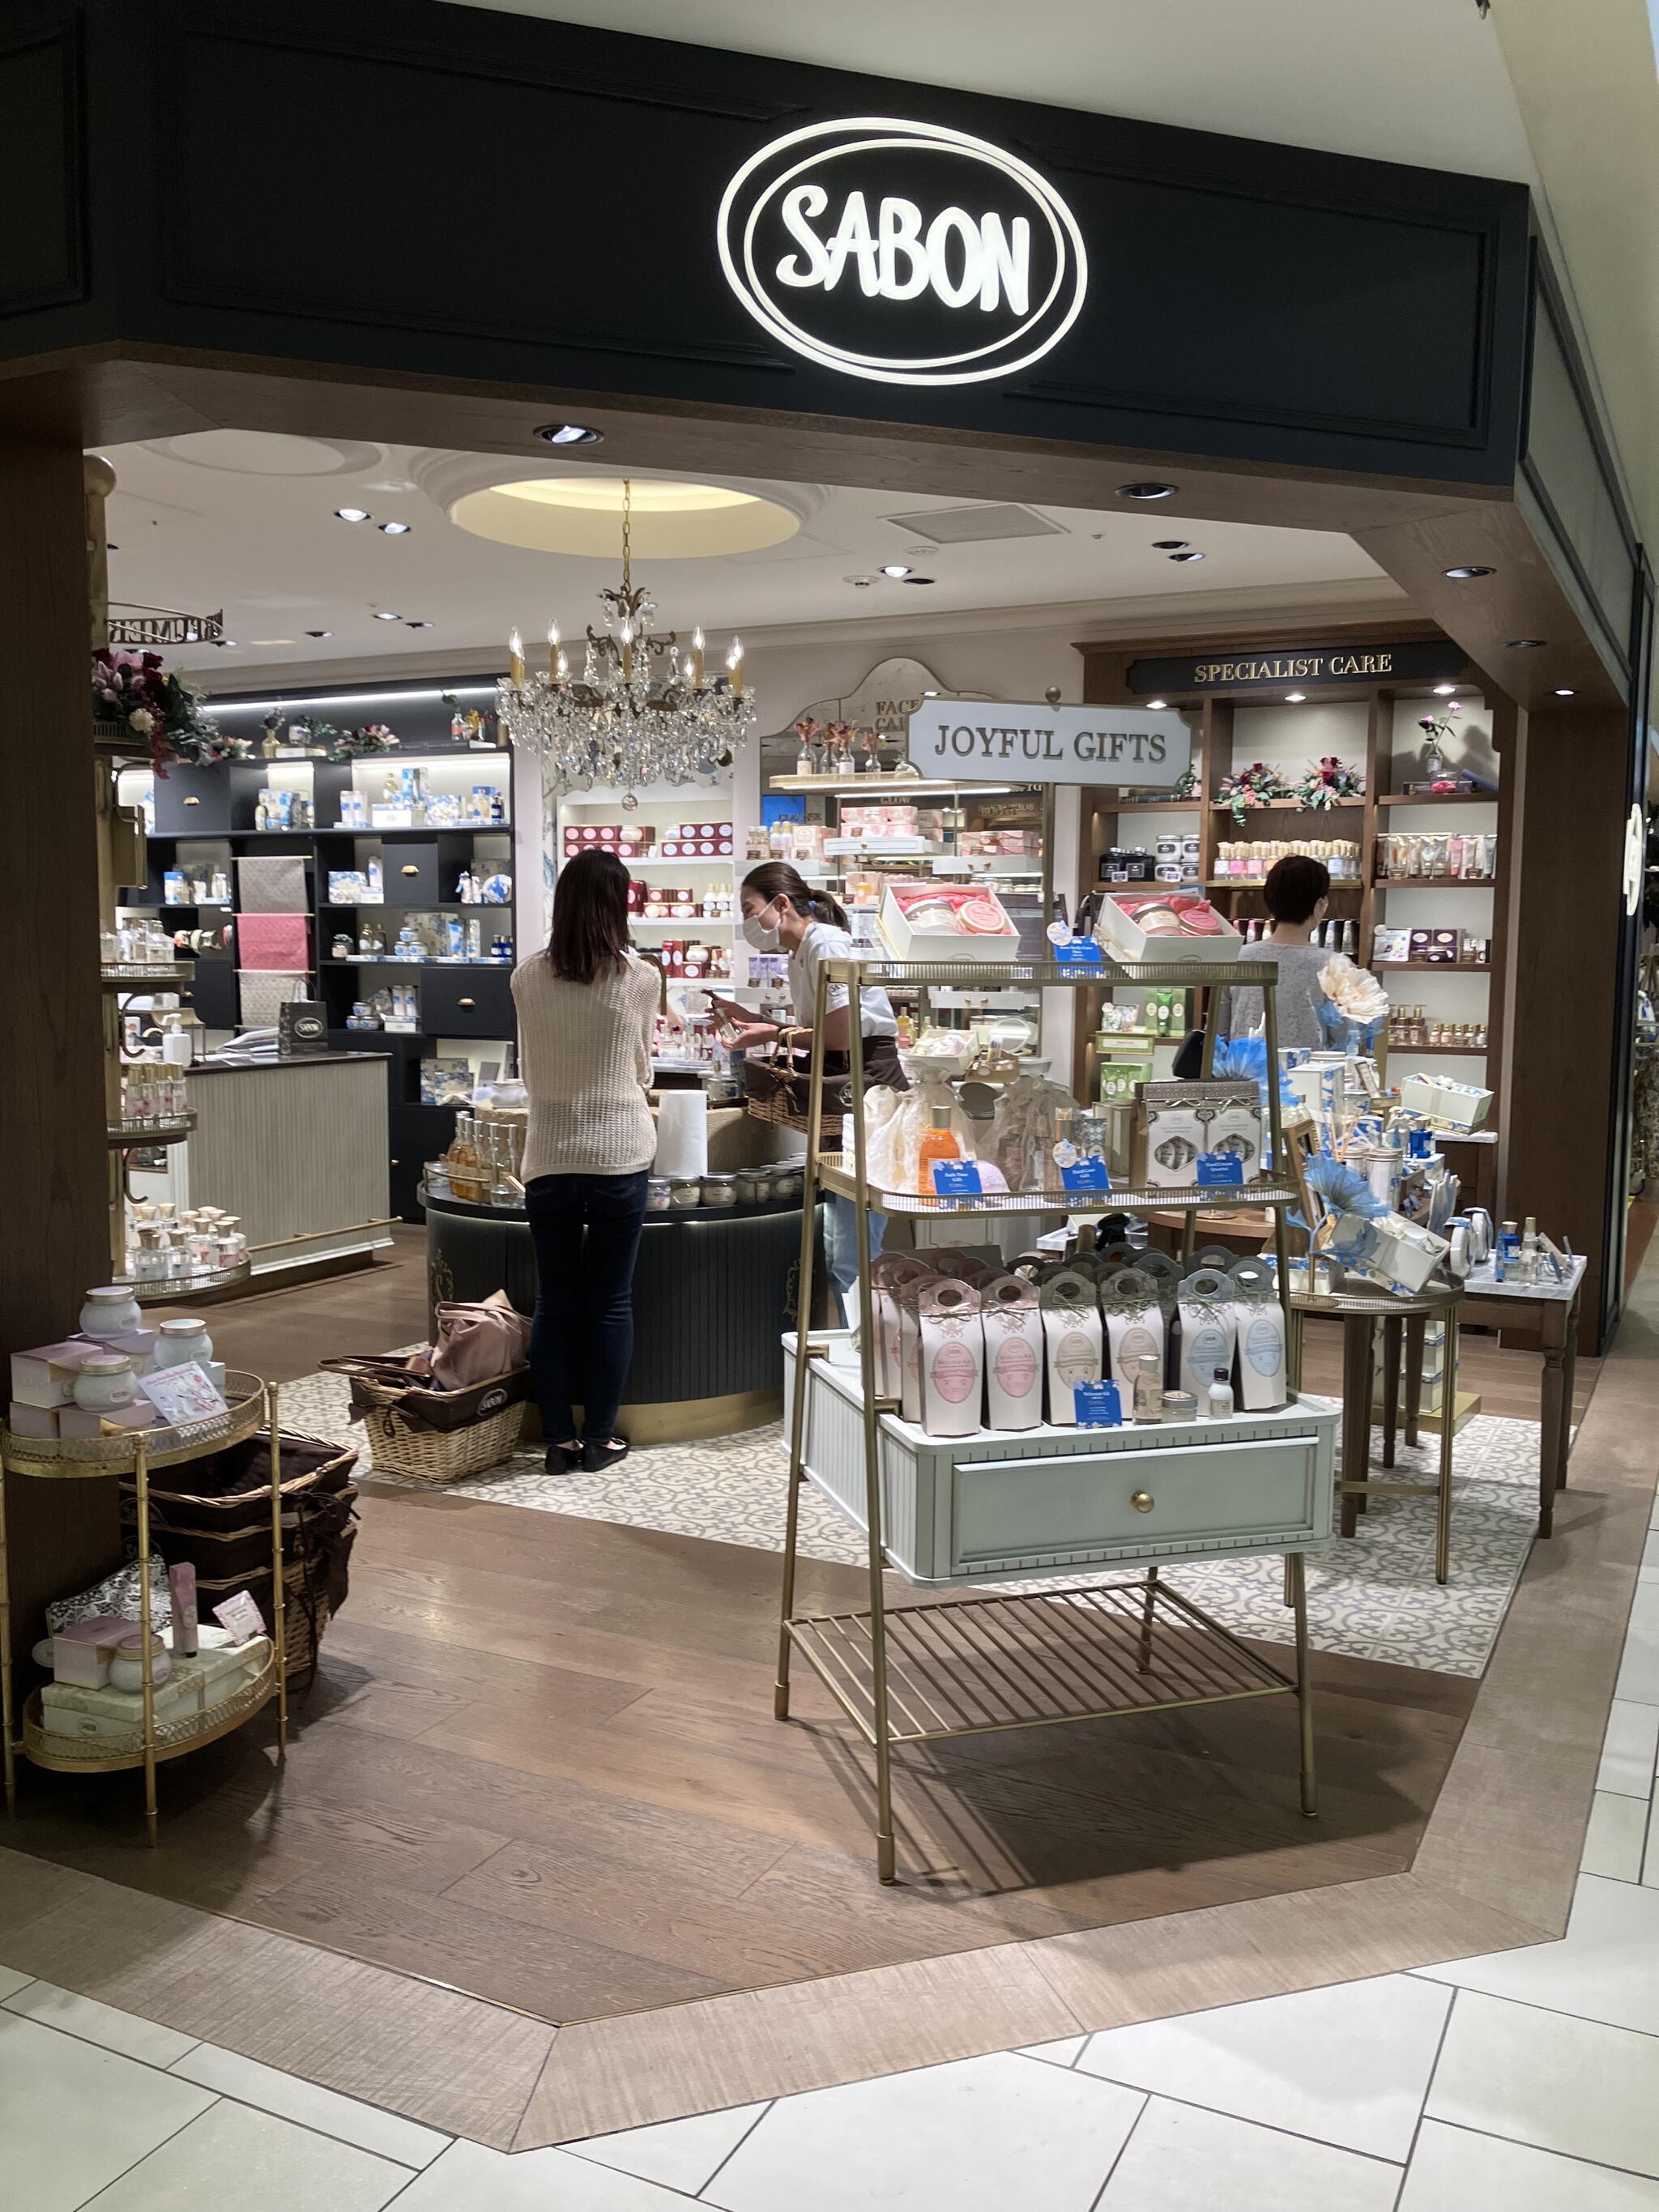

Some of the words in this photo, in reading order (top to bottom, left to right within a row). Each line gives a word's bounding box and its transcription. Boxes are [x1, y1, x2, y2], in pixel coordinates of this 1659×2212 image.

[776, 185, 1030, 316] SABON
[1194, 658, 1323, 683] SPECIALIST
[1329, 654, 1392, 675] CARE
[876, 717, 906, 731] CA
[935, 726, 1063, 760] JOYFUL
[1074, 731, 1166, 763] GIFTS
